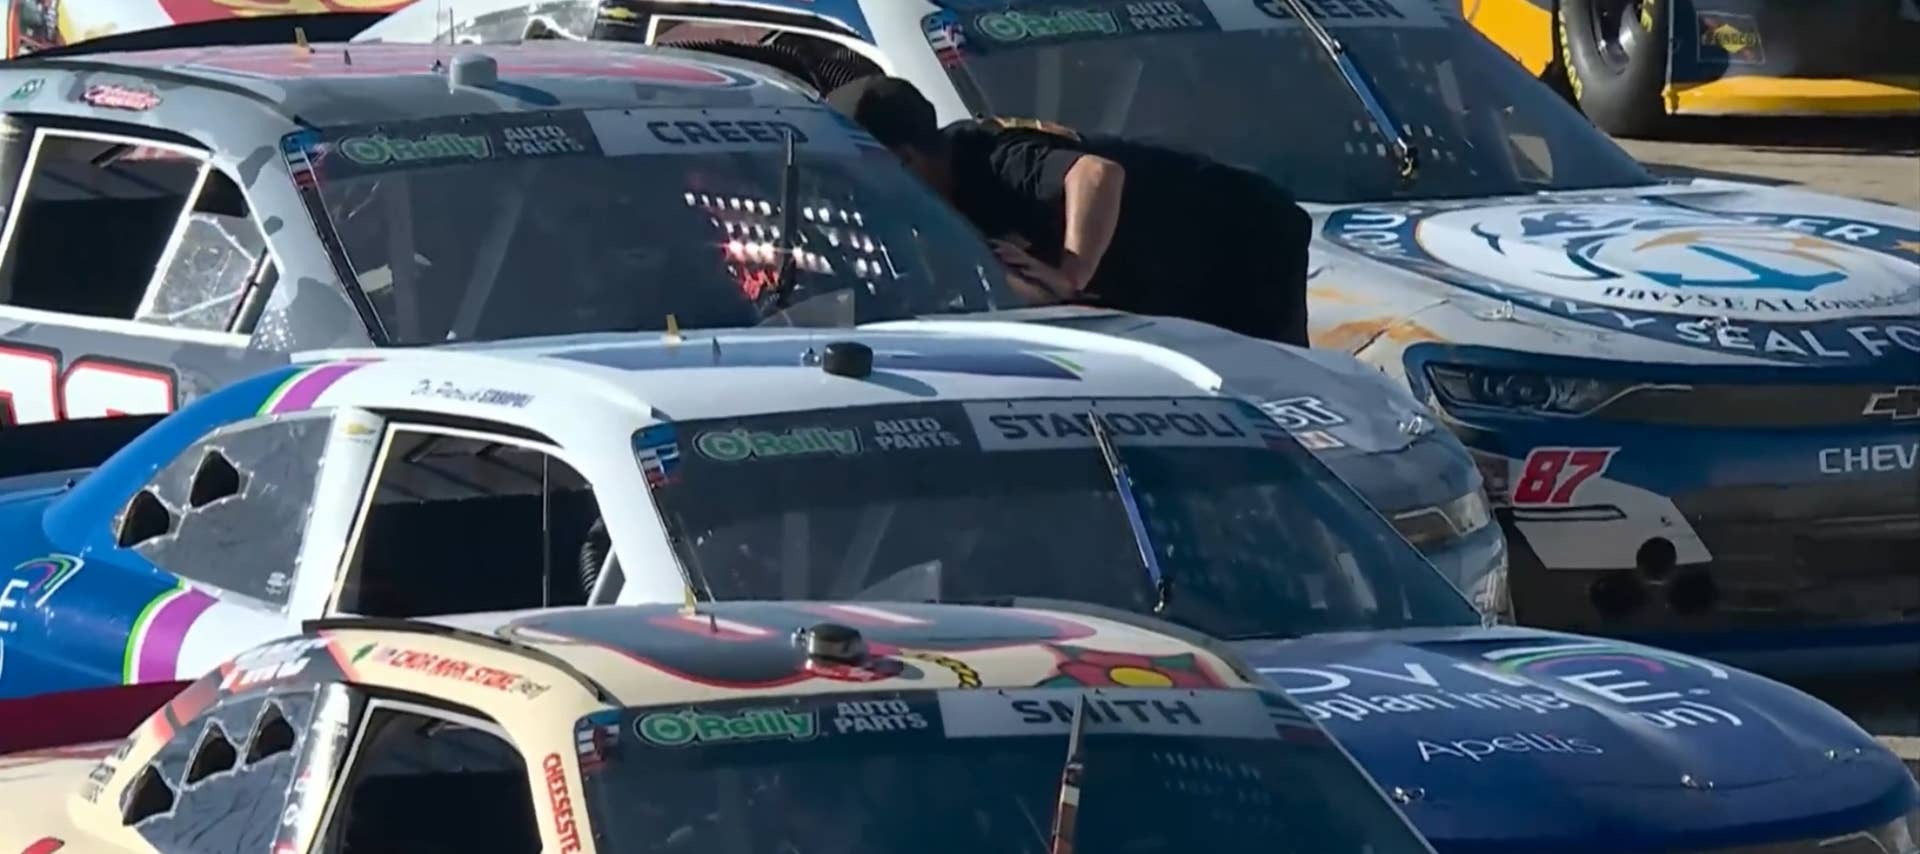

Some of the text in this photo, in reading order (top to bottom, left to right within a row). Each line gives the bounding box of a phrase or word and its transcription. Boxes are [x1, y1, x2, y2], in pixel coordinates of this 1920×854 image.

[1126, 1, 1184, 15] AUTO
[1127, 14, 1204, 31] PARTS
[503, 125, 566, 141] AUTO
[647, 119, 810, 146] CREED
[503, 138, 585, 156] PARTS
[873, 416, 942, 434] AUTO
[698, 426, 861, 461] O'Reilly
[874, 431, 961, 451] PARTS
[1513, 446, 1621, 507] 87
[836, 700, 910, 717] AUTO
[1010, 698, 1202, 727] SMITH
[638, 708, 818, 746] O'Reilly
[833, 713, 928, 735] PARTS
[1416, 732, 1604, 762] Apellis
